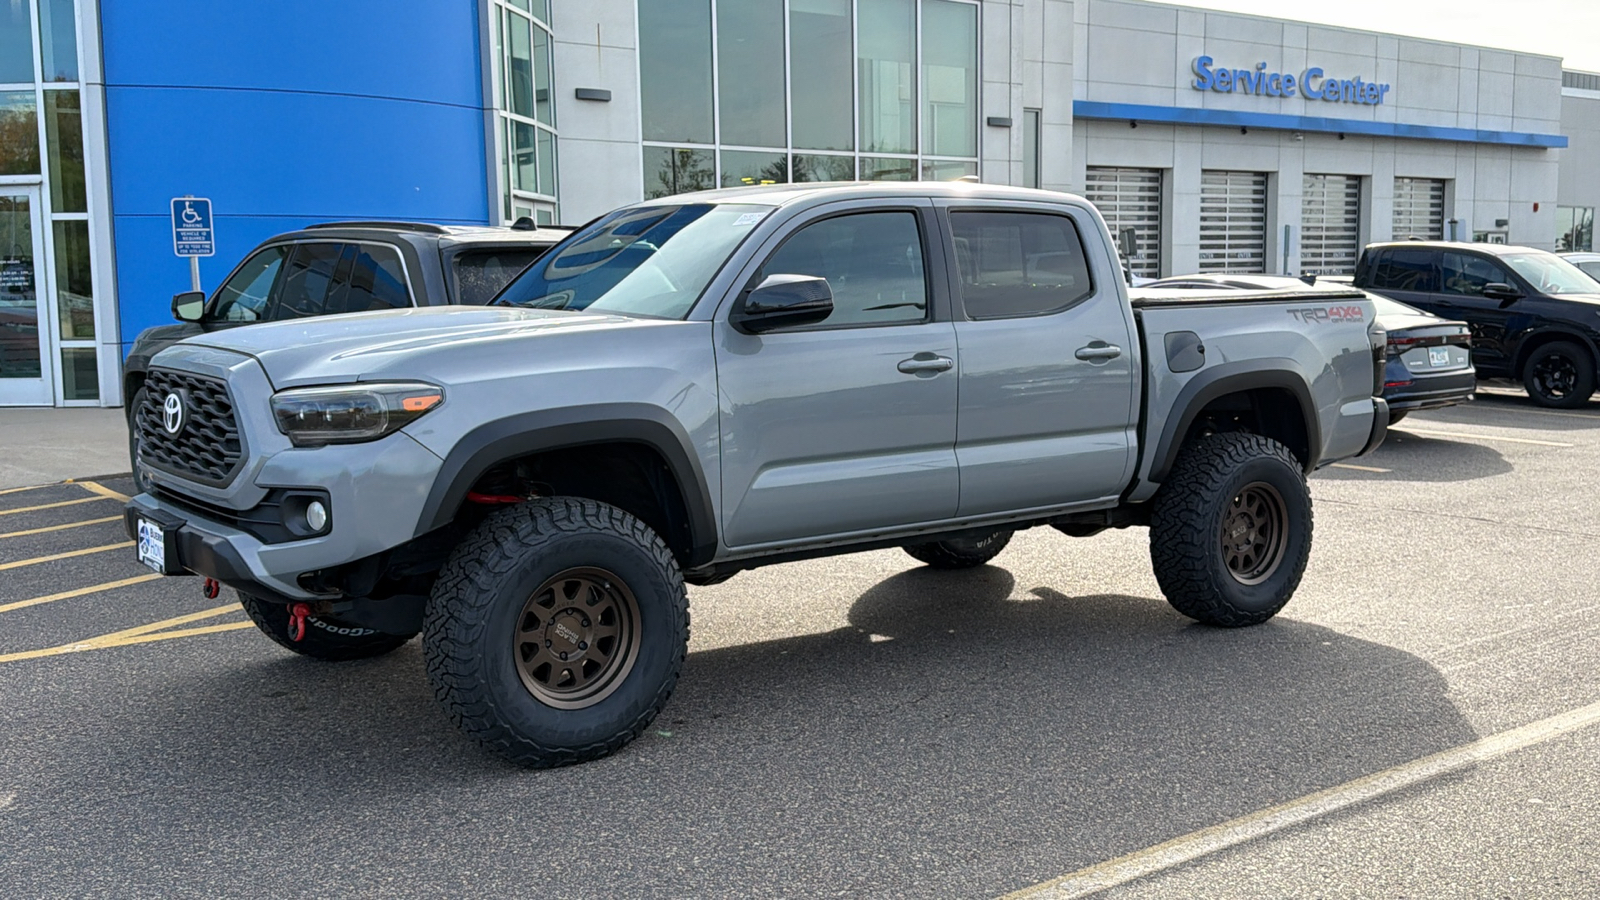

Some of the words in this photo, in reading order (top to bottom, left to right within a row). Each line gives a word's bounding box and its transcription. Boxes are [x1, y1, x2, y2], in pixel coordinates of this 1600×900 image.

[1192, 55, 1296, 98] Service
[1300, 67, 1390, 105] Center
[1286, 308, 1329, 325] TRD
[555, 628, 576, 644] BLACK
[557, 623, 579, 640] RHINO
